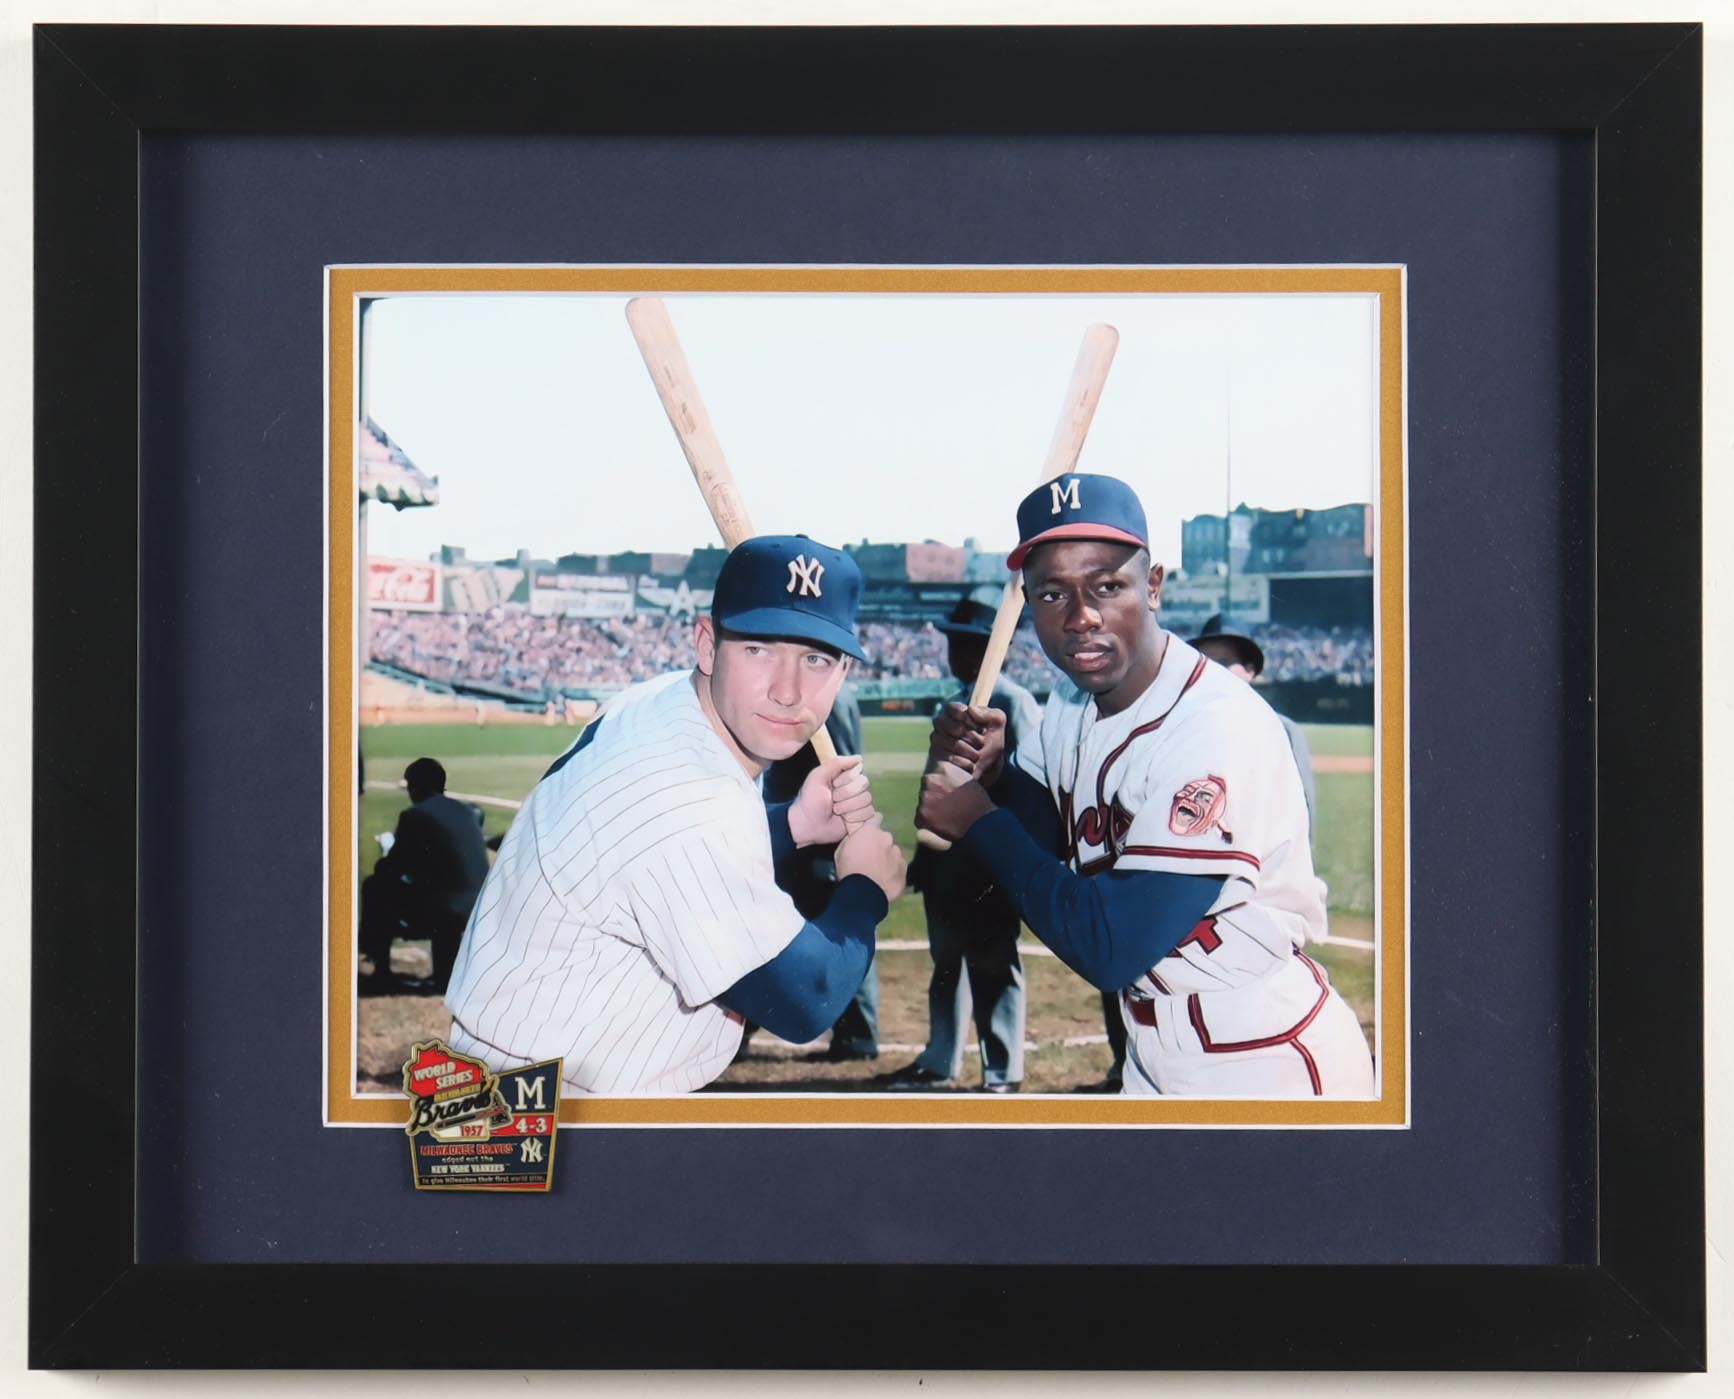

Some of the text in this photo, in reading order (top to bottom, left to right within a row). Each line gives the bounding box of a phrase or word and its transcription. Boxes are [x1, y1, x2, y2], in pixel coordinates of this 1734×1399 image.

[1050, 478, 1081, 515] M
[786, 554, 825, 598] NY
[414, 1062, 456, 1081] WORLD
[436, 1070, 473, 1089] SERIES
[515, 1076, 545, 1110] M
[411, 1079, 495, 1131] Braves
[460, 1125, 484, 1137] 1957
[515, 1118, 547, 1133] 4-3
[420, 1143, 513, 1156] MILWAUKEE BRAVES
[520, 1137, 543, 1163] NY
[431, 1163, 505, 1174] NEW YORK YANKEES
